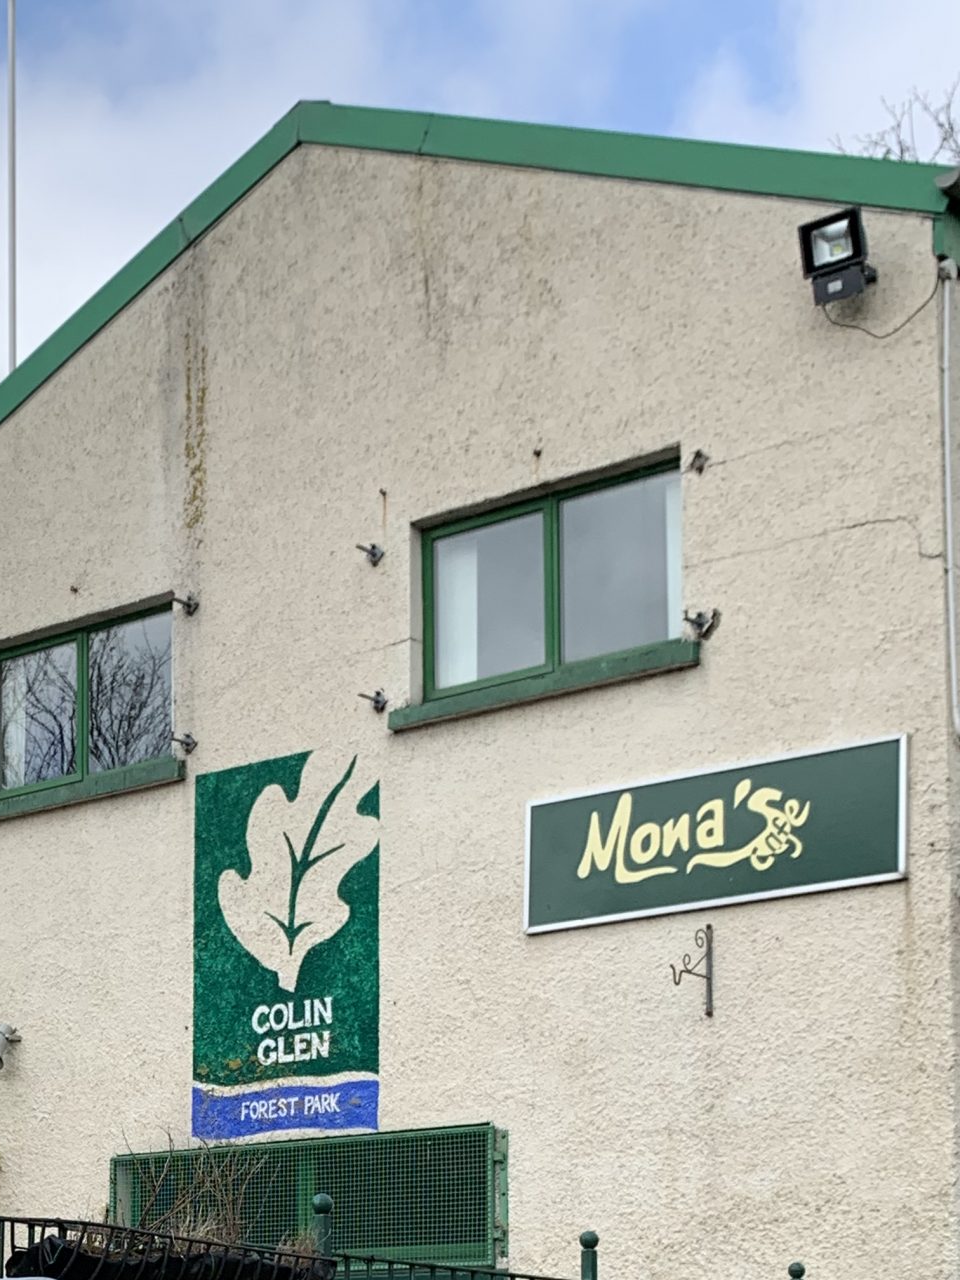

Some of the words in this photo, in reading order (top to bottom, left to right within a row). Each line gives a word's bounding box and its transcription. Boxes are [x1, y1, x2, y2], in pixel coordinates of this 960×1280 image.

[577, 779, 790, 883] Mona's
[251, 997, 333, 1034] COLIN
[257, 1031, 330, 1066] GLEN
[241, 1096, 299, 1121] FOREST
[304, 1092, 340, 1114] PARK
